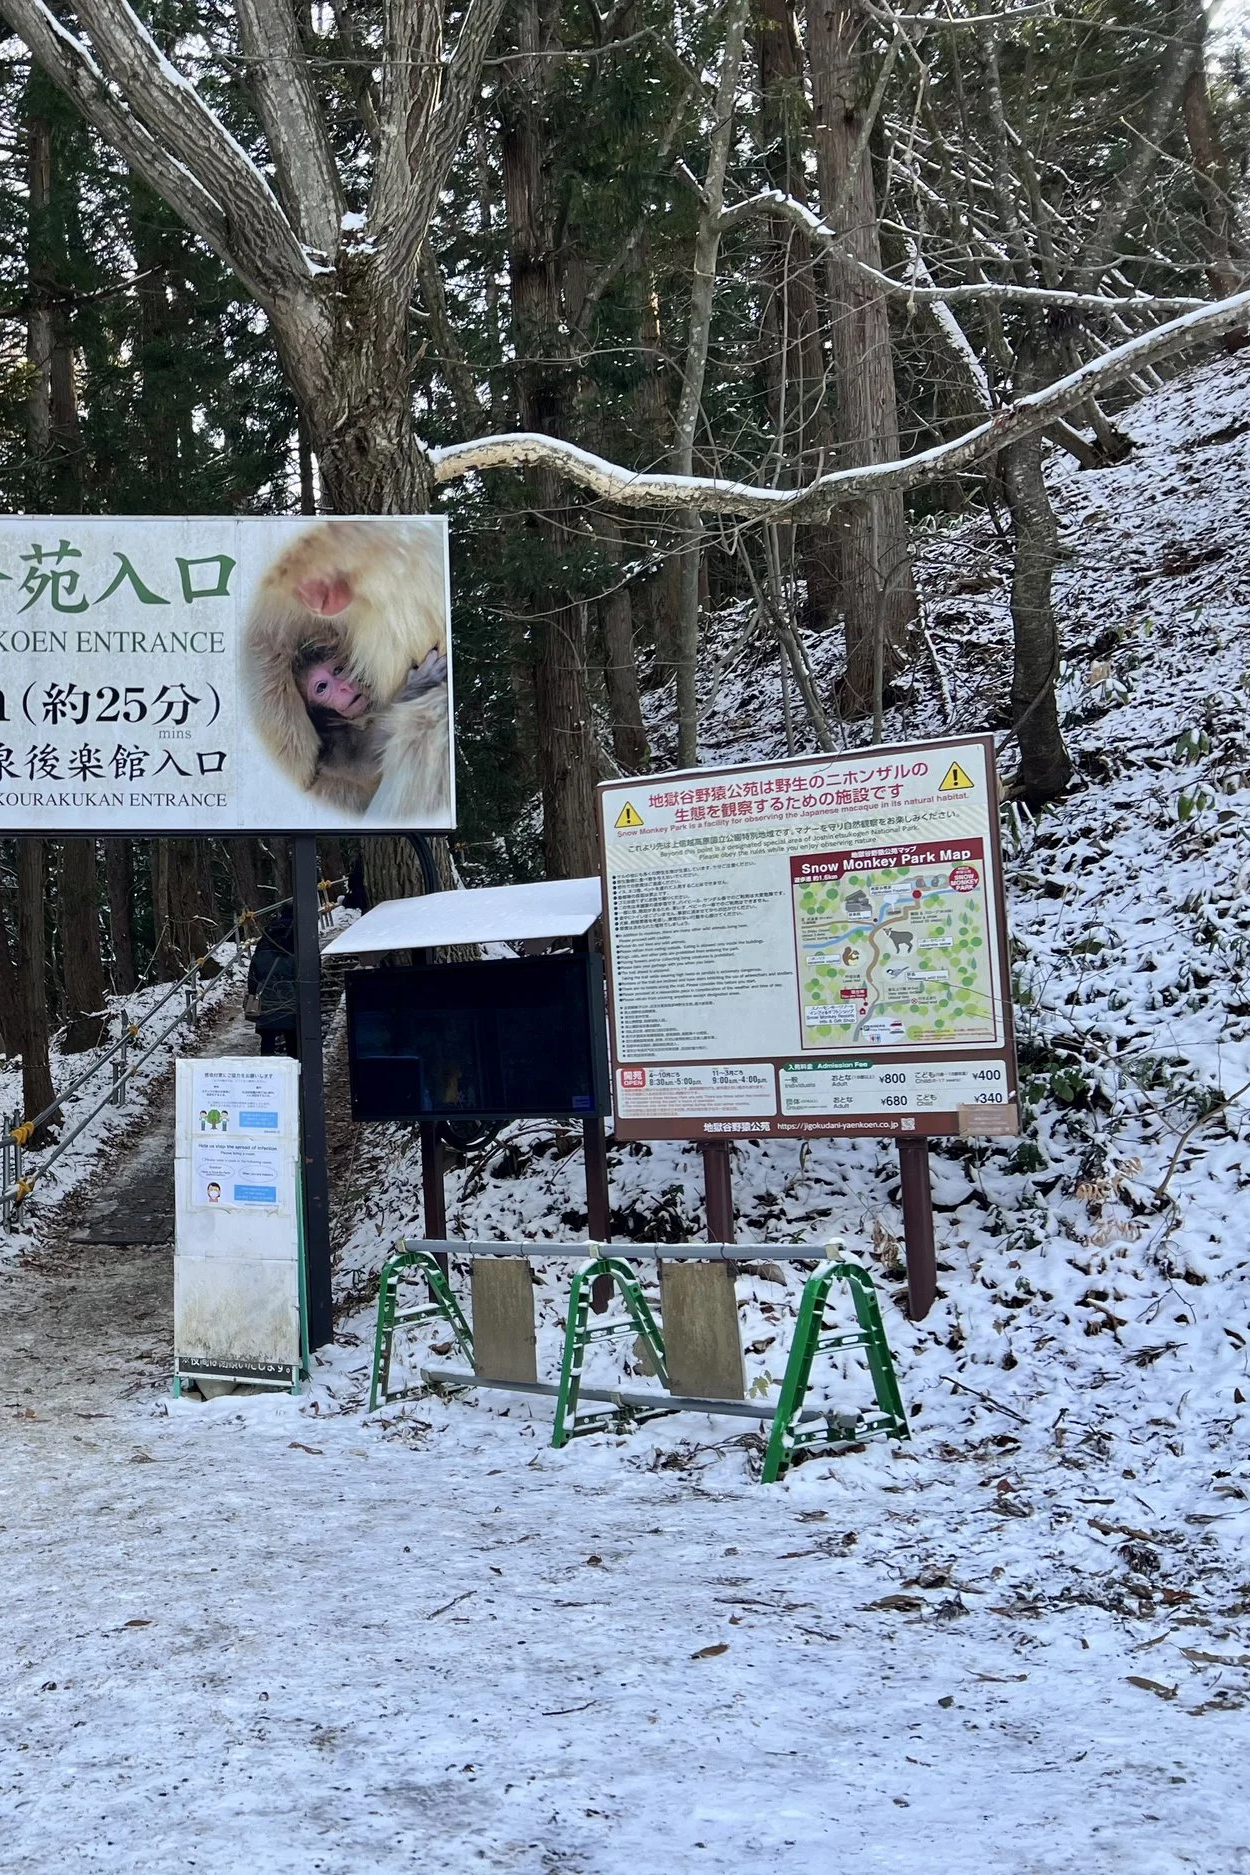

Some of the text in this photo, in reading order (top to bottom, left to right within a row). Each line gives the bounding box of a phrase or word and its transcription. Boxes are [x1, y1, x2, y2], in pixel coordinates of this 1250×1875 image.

[76, 630, 226, 653] ENTRANCE
[158, 727, 192, 740] mins
[648, 762, 929, 808] 地獄谷野猿公苑は野生のニホンザルの
[129, 793, 228, 808] ENTRANCE
[674, 783, 904, 823] 生態を観察するための施設です
[617, 829, 637, 838] Snow
[639, 826, 668, 835] Monkey
[704, 819, 729, 829] facility
[731, 817, 742, 825] for
[744, 813, 784, 824] observing
[785, 811, 798, 819] the
[800, 807, 839, 818] Japanese
[841, 803, 879, 814] macaque
[891, 800, 901, 808] its
[904, 796, 934, 805] natural
[936, 792, 969, 802] habitat.
[660, 849, 683, 858] Beyond
[698, 846, 713, 855] point
[729, 840, 761, 851] designated
[764, 838, 786, 848] special
[871, 826, 901, 836] National
[700, 852, 721, 860] Please
[723, 850, 740, 860] obey
[741, 848, 752, 856] the
[784, 844, 796, 853] you
[798, 841, 818, 852] enjoy
[820, 838, 853, 849] observing
[801, 849, 971, 874] Snow Monkey Park Map
[950, 878, 979, 886] MONKEY
[831, 1074, 852, 1082] おとな
[879, 1073, 906, 1084] ¥800
[915, 1071, 936, 1079] こども
[972, 1069, 1001, 1081] ¥400
[833, 1096, 853, 1104] おとな
[880, 1095, 908, 1107] ¥680
[973, 1092, 1003, 1104] ¥340
[703, 1121, 899, 1133] 地獄谷野猿公苑 https://jigokudani-yaenkoen.co.jp
